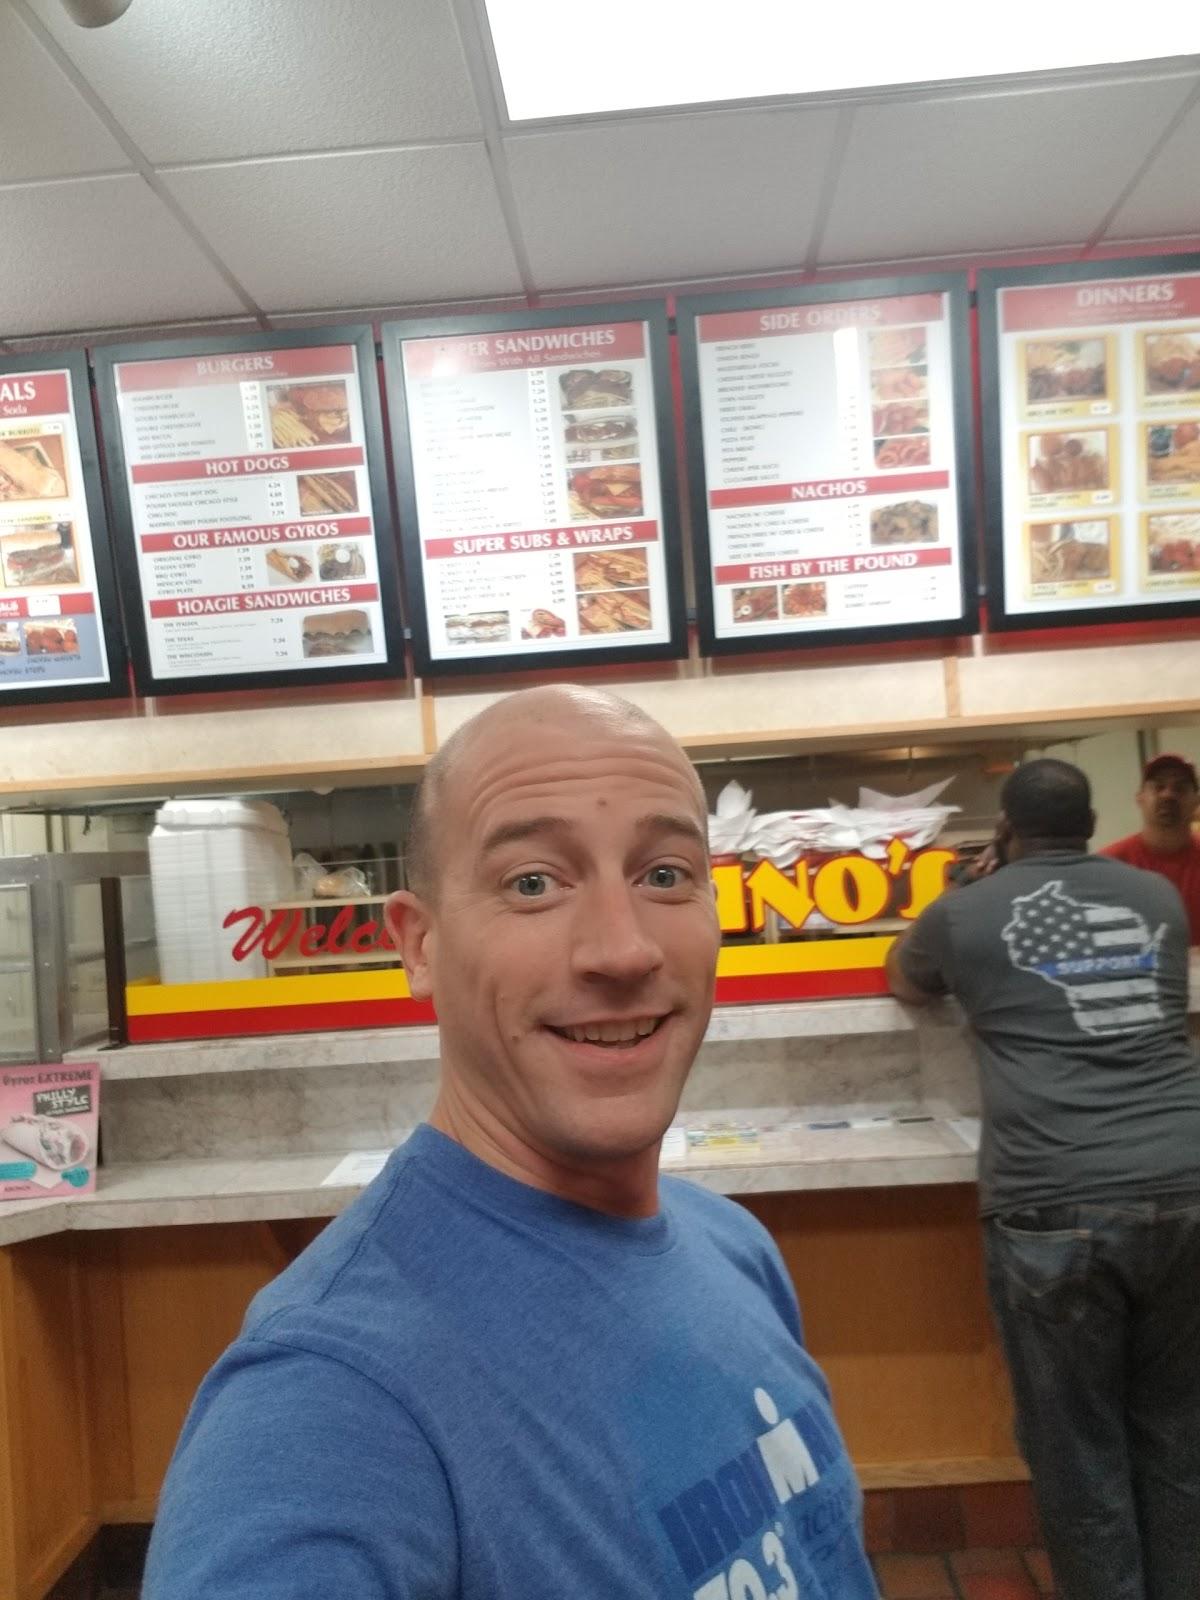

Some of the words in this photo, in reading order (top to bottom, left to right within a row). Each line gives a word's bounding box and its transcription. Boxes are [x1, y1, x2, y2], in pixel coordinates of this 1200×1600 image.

[1077, 282, 1174, 307] DINNERS
[760, 314, 800, 331] SIDE
[806, 305, 881, 326] ORDERS
[496, 329, 616, 354] SANDWICHES
[196, 356, 274, 374] BURGERS
[3, 405, 27, 415] Soda
[206, 461, 238, 475] HOT
[244, 456, 289, 471] DOGS
[792, 481, 868, 498] NACHOS
[174, 533, 209, 548] OUR
[214, 528, 280, 544] FAMOUS
[285, 523, 339, 538] GYROS
[453, 538, 506, 554] SUPER
[510, 533, 551, 549] SUBS
[557, 532, 570, 546] &
[574, 527, 633, 544] WRAPS
[750, 564, 785, 579] FISH
[791, 562, 812, 576] BY
[818, 559, 848, 573] THE
[855, 553, 918, 570] POUND
[177, 598, 240, 614] HOAGIE
[244, 588, 350, 610] SANDWICHES
[39, 1070, 91, 1084] EXTREME
[36, 1088, 76, 1102] PHILLY
[51, 1096, 89, 1109] STYLE
